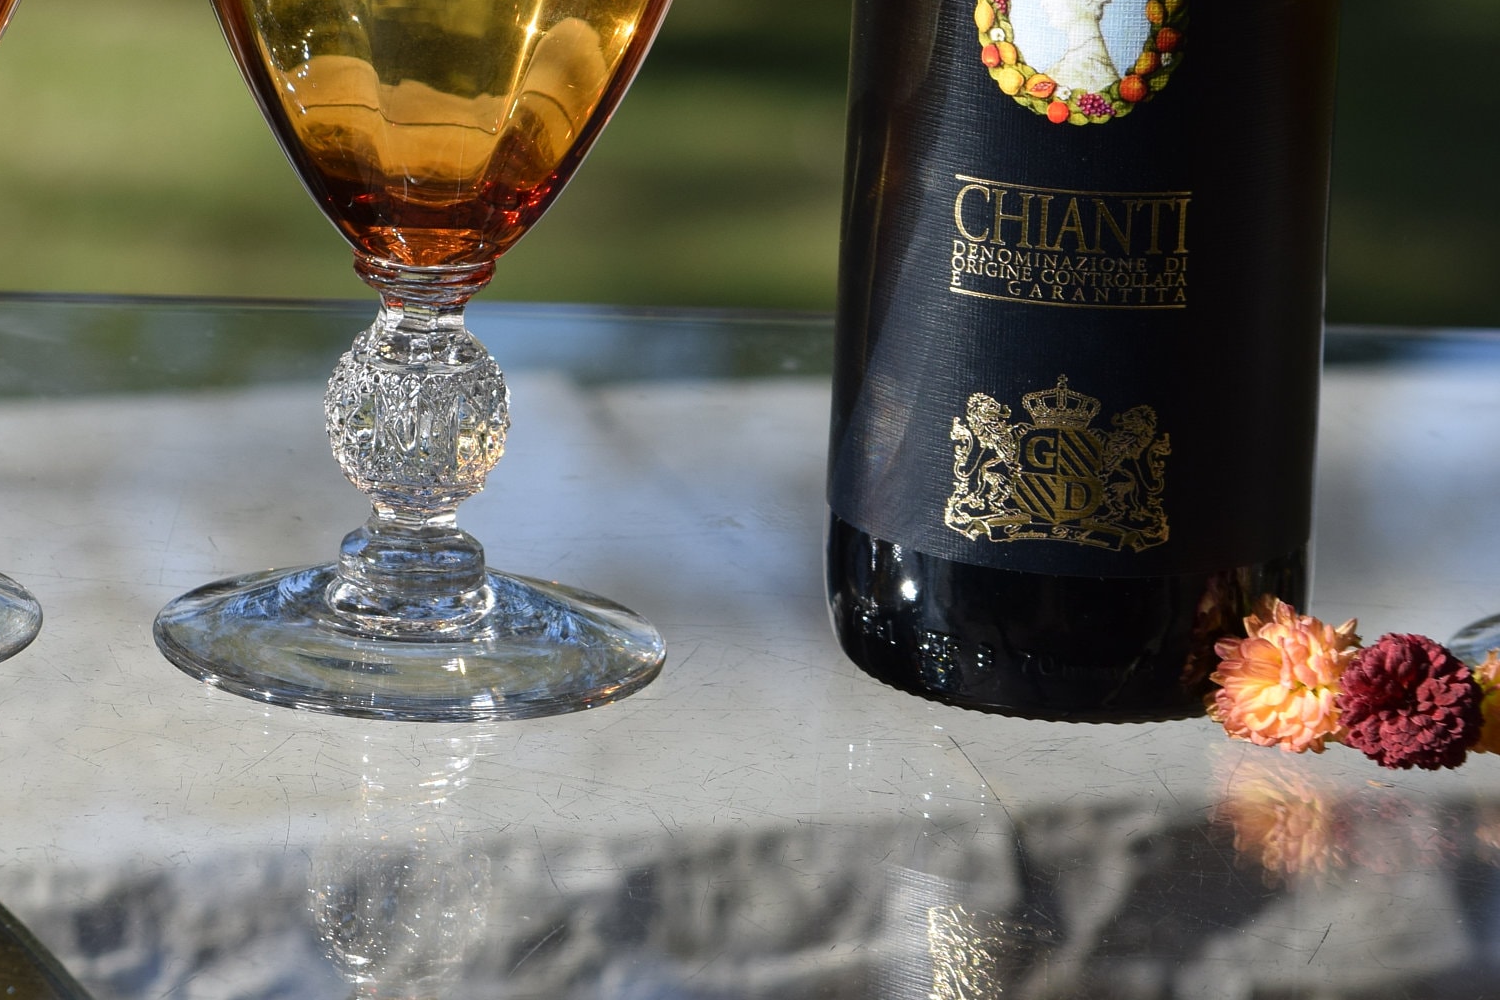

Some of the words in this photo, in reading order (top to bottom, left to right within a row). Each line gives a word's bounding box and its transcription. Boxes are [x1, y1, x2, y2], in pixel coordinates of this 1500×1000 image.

[954, 184, 1192, 255] CHIANTI
[953, 239, 1147, 272] DENOMINAZIONE
[1165, 257, 1188, 272] DI
[950, 271, 962, 286] E
[1007, 280, 1187, 303] GARANTITA
[951, 256, 1033, 282] ORIGINE
[1040, 269, 1188, 289] CONTROLLATA
[1026, 436, 1057, 469] G
[1062, 481, 1091, 512] D
